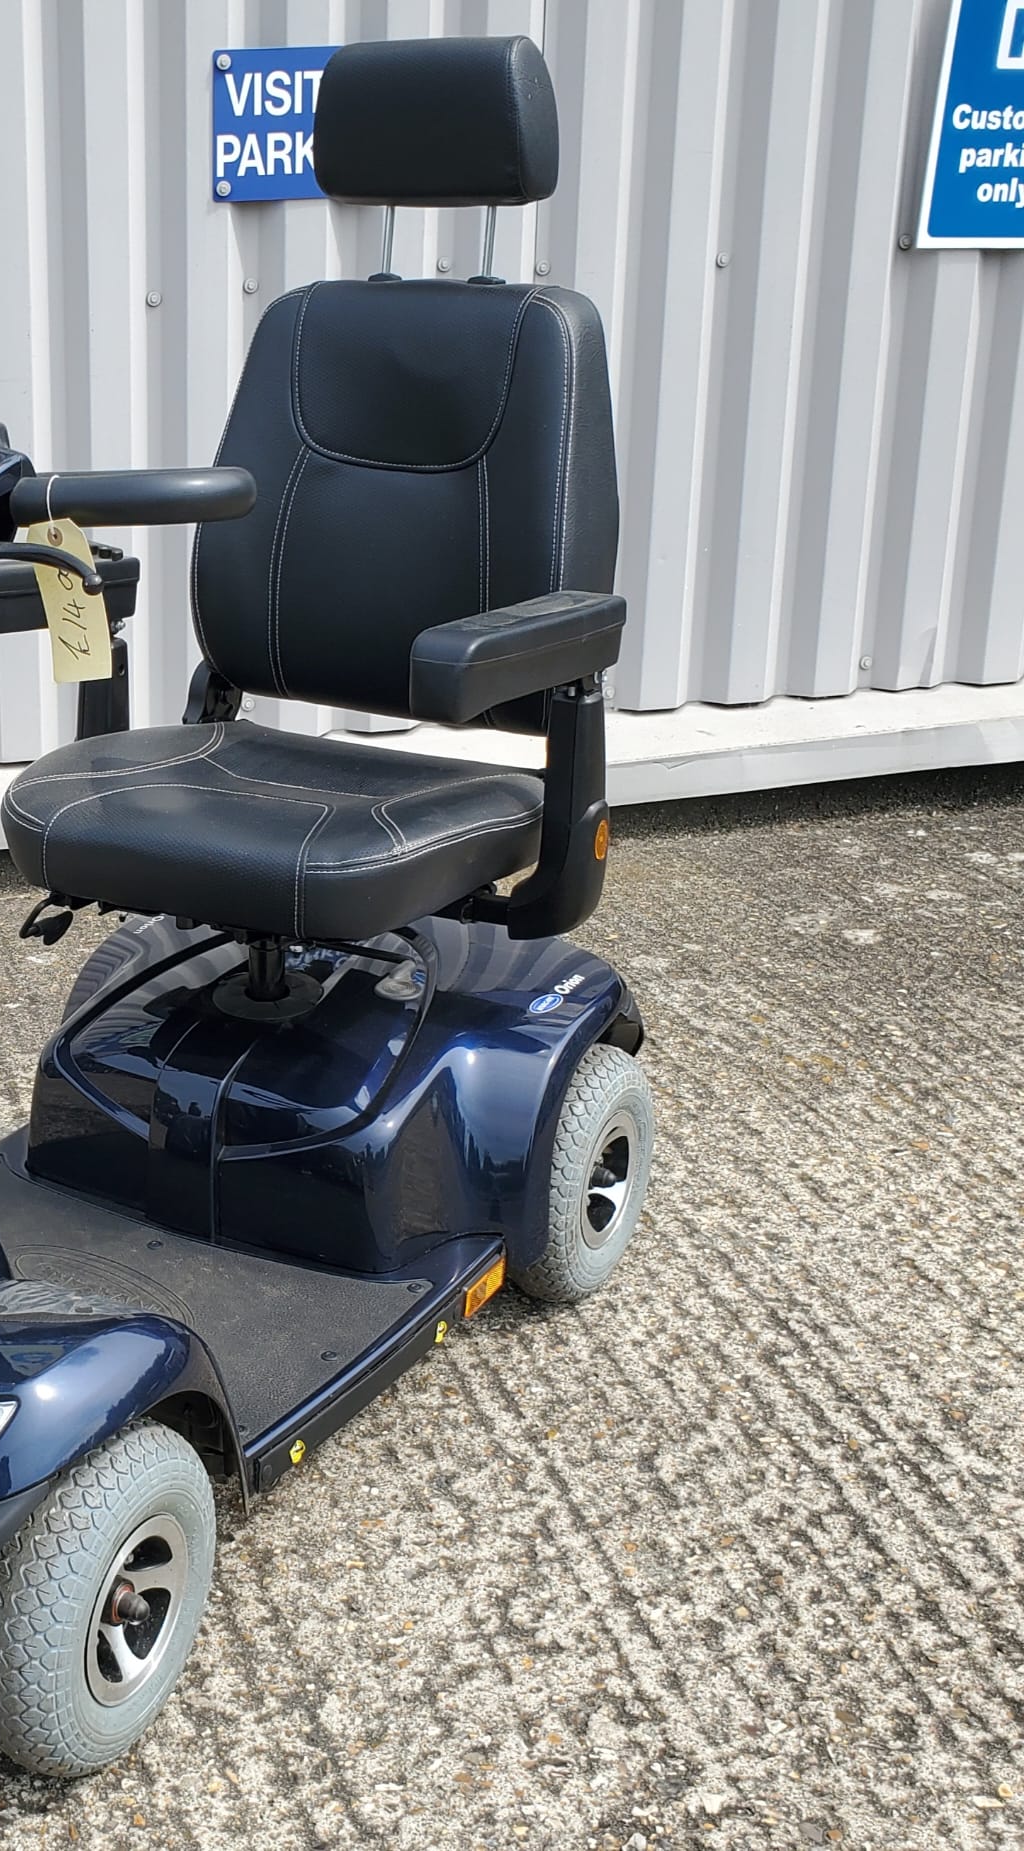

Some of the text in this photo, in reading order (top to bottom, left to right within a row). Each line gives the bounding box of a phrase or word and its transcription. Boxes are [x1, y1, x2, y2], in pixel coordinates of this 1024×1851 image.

[224, 70, 324, 116] VISIT
[216, 131, 314, 178] PARK
[554, 974, 585, 995] Orion
